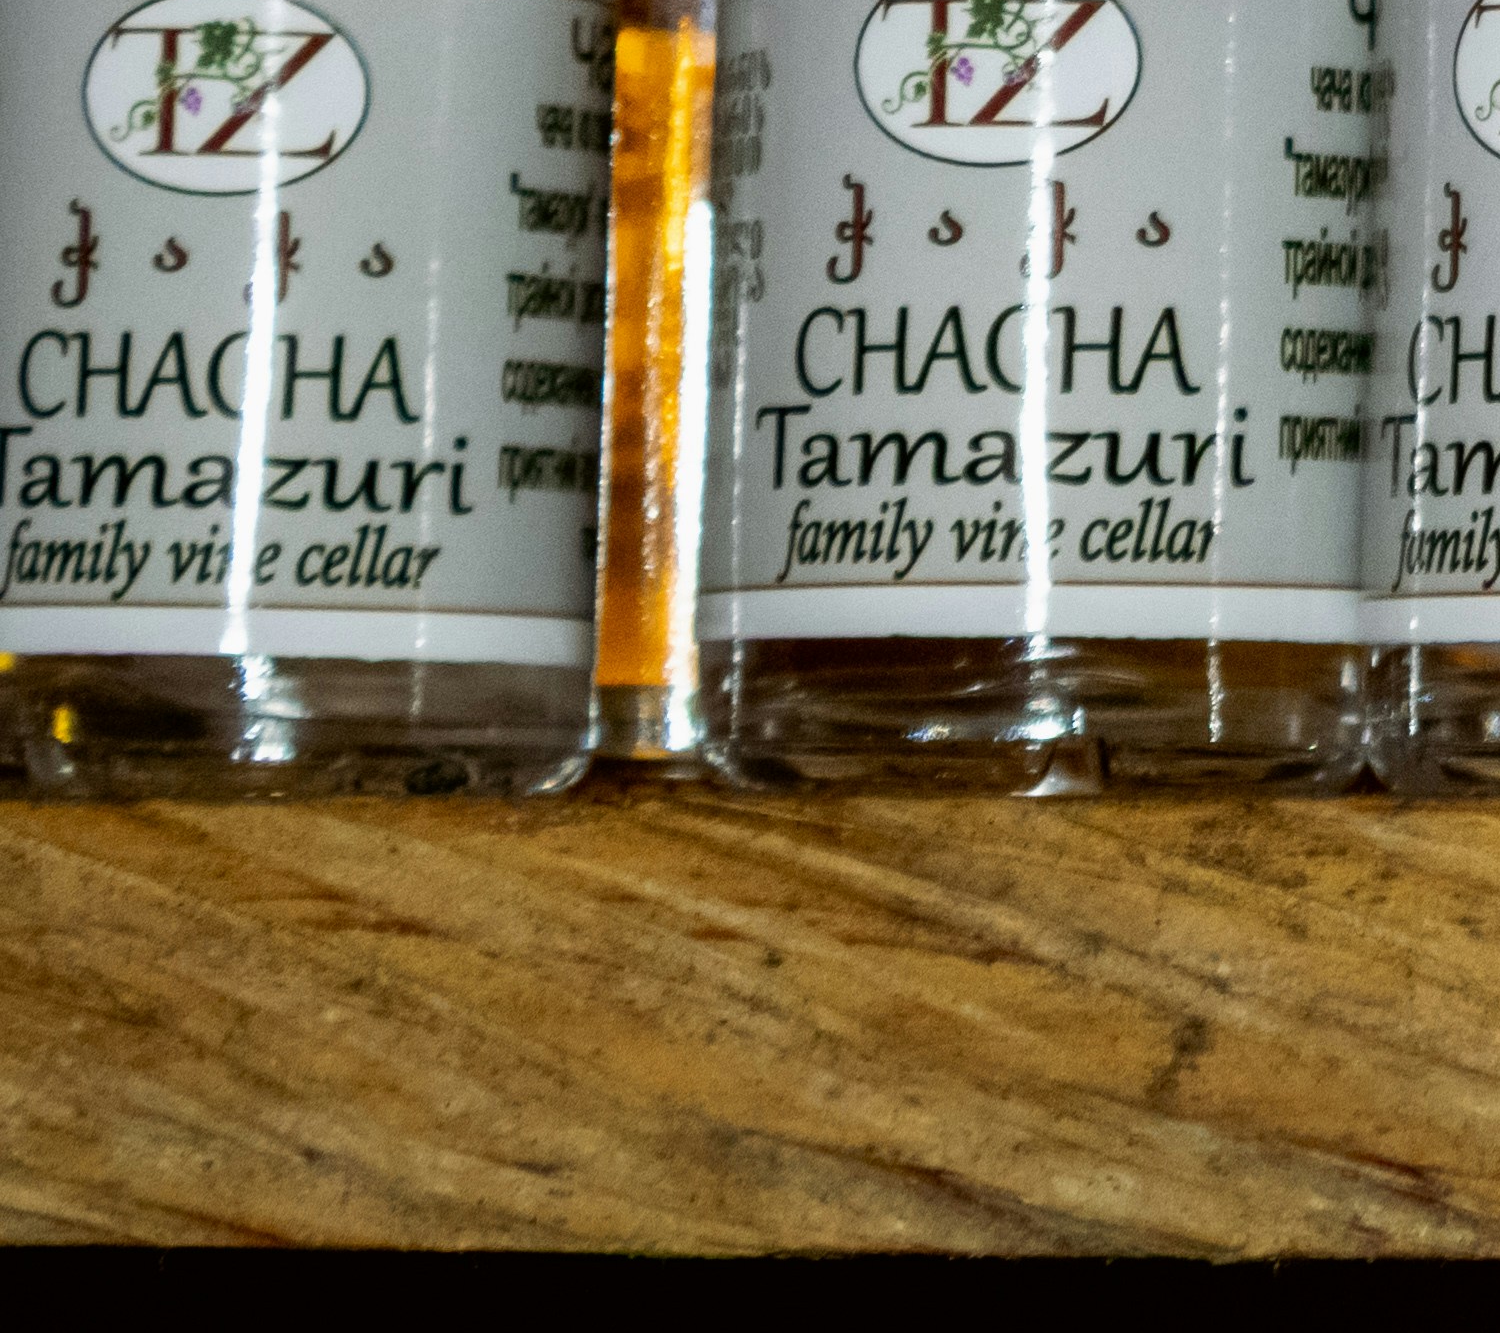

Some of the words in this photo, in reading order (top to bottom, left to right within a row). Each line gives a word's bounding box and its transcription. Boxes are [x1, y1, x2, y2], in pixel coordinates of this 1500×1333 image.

[18, 328, 421, 422] CHACHA
[795, 304, 1202, 399] CHACHA
[755, 404, 1257, 491] Tamazuri
[0, 518, 151, 602] family
[295, 523, 442, 591] cellar
[775, 496, 936, 585] family
[1080, 496, 1221, 564] cellar
